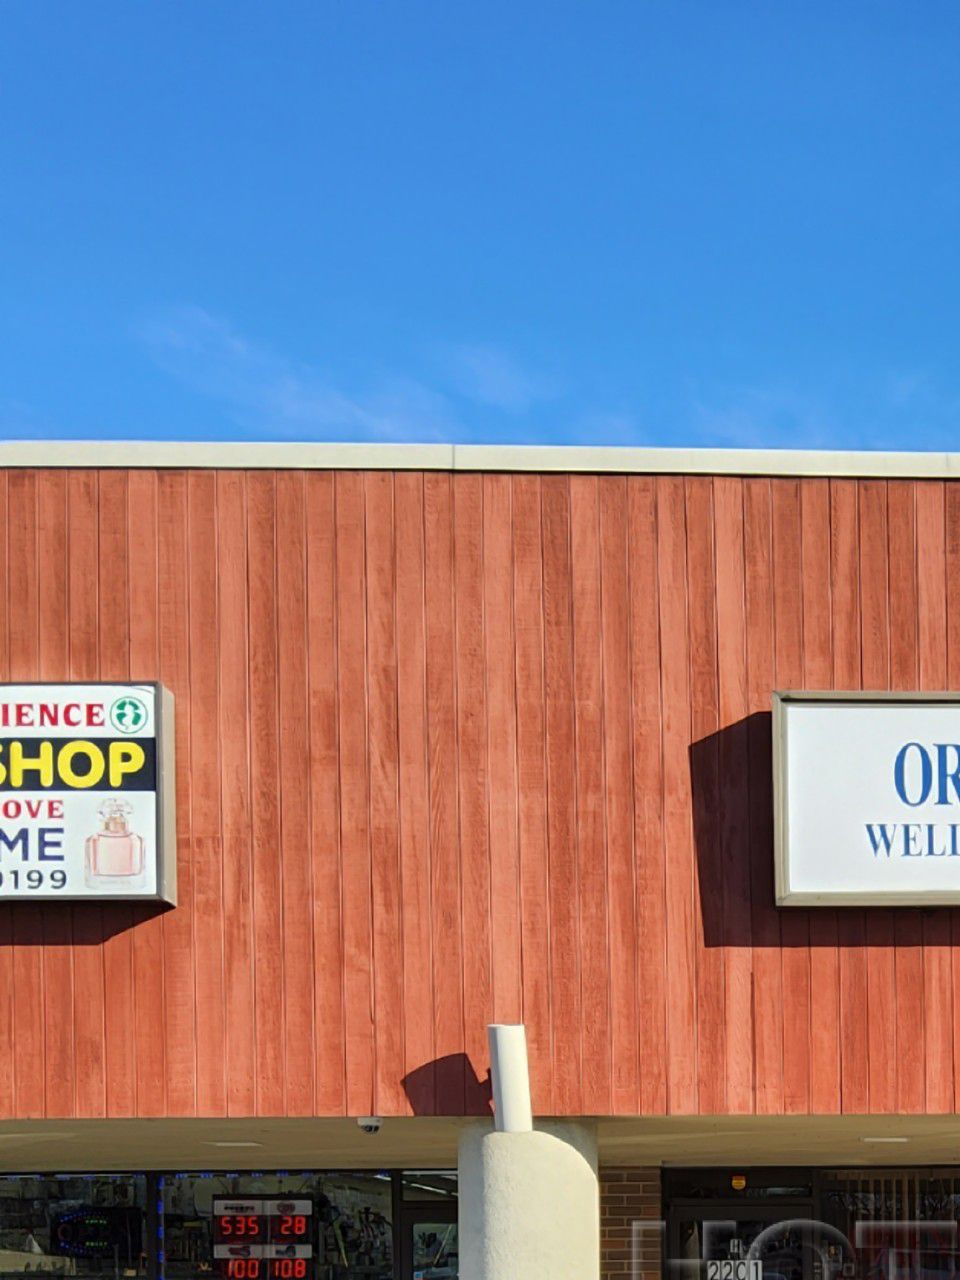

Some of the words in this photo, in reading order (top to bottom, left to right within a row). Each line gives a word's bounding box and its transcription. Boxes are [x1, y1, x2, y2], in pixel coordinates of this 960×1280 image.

[2, 703, 105, 727] IENCE
[0, 869, 67, 889] 199
[221, 1215, 259, 1235] 535
[280, 1215, 306, 1235] 28
[228, 1259, 259, 1278] 100
[275, 1259, 306, 1278] 108
